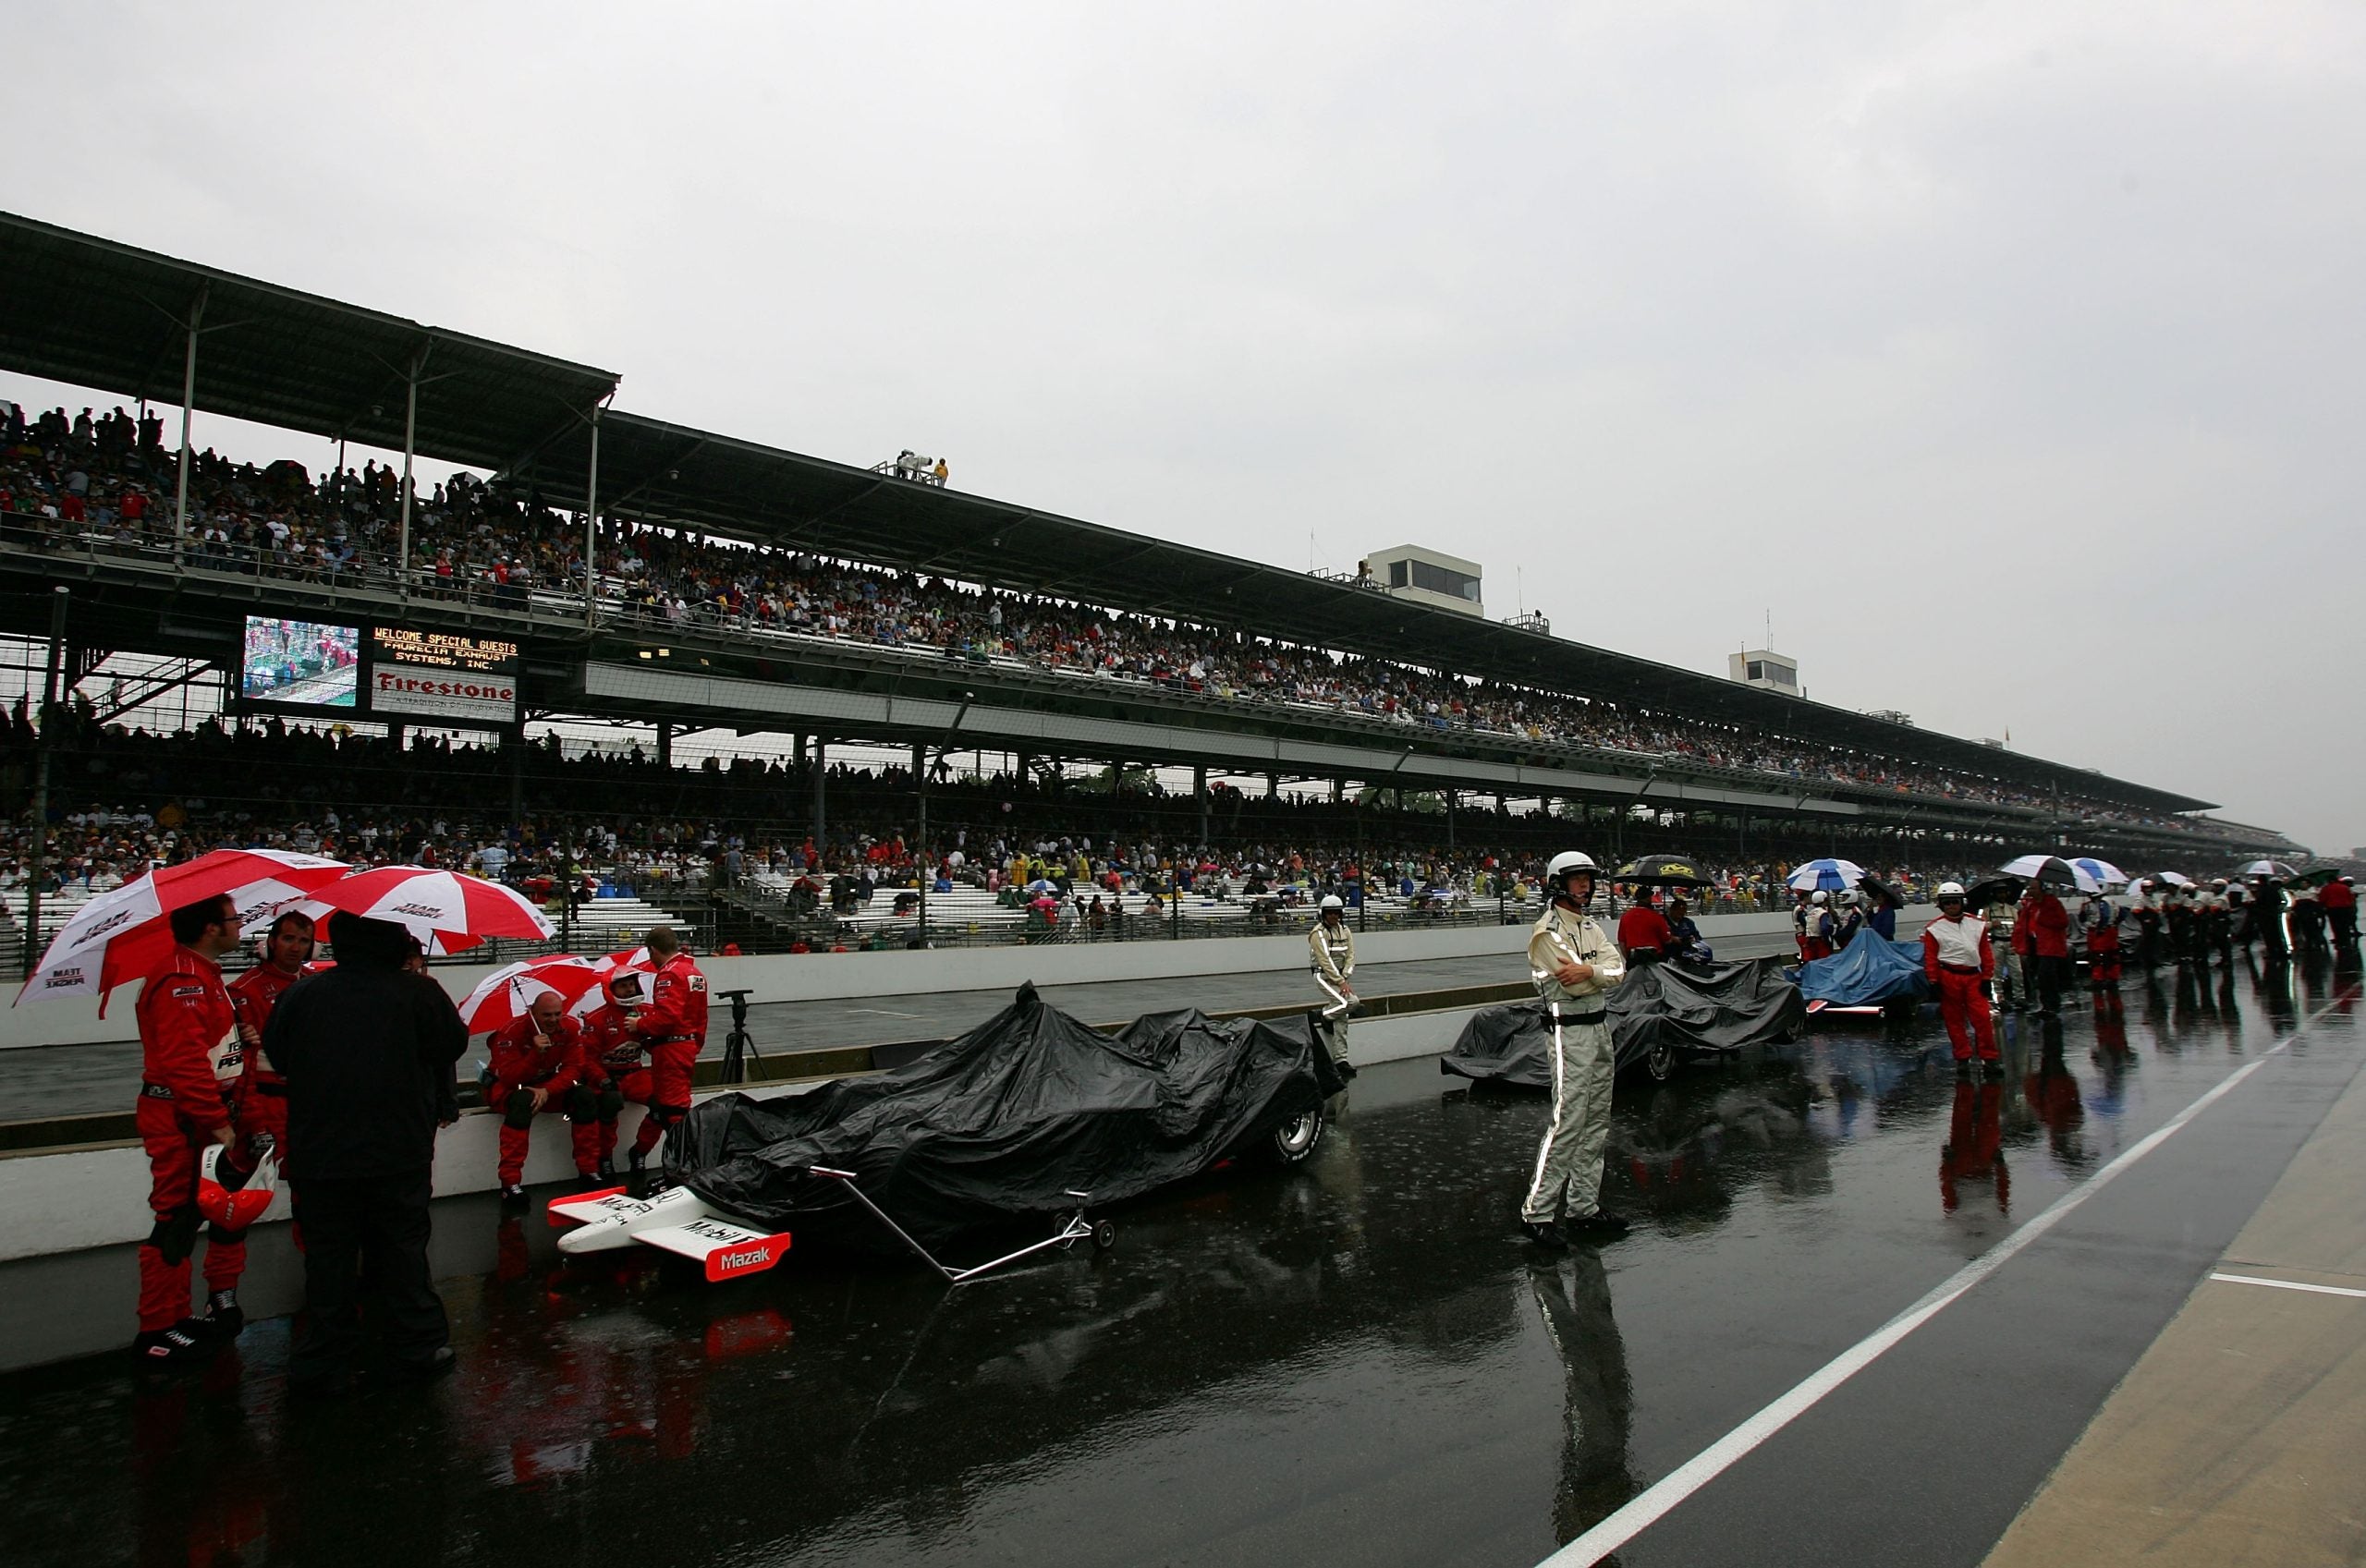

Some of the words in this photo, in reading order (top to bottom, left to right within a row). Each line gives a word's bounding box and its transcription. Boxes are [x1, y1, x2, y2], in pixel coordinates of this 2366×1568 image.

[374, 626, 423, 642] WELCOME
[429, 633, 474, 649] SPECIAL
[479, 639, 518, 653] GUESTS
[384, 641, 449, 655] FAURECIA
[455, 649, 508, 662] EXHAUST
[395, 651, 458, 666] SYSTEMS,
[467, 660, 494, 671] INC.
[377, 673, 514, 701] Firestone
[405, 902, 442, 913] TEAM
[680, 1221, 742, 1242] Mobil
[721, 1246, 771, 1271] Mazak
